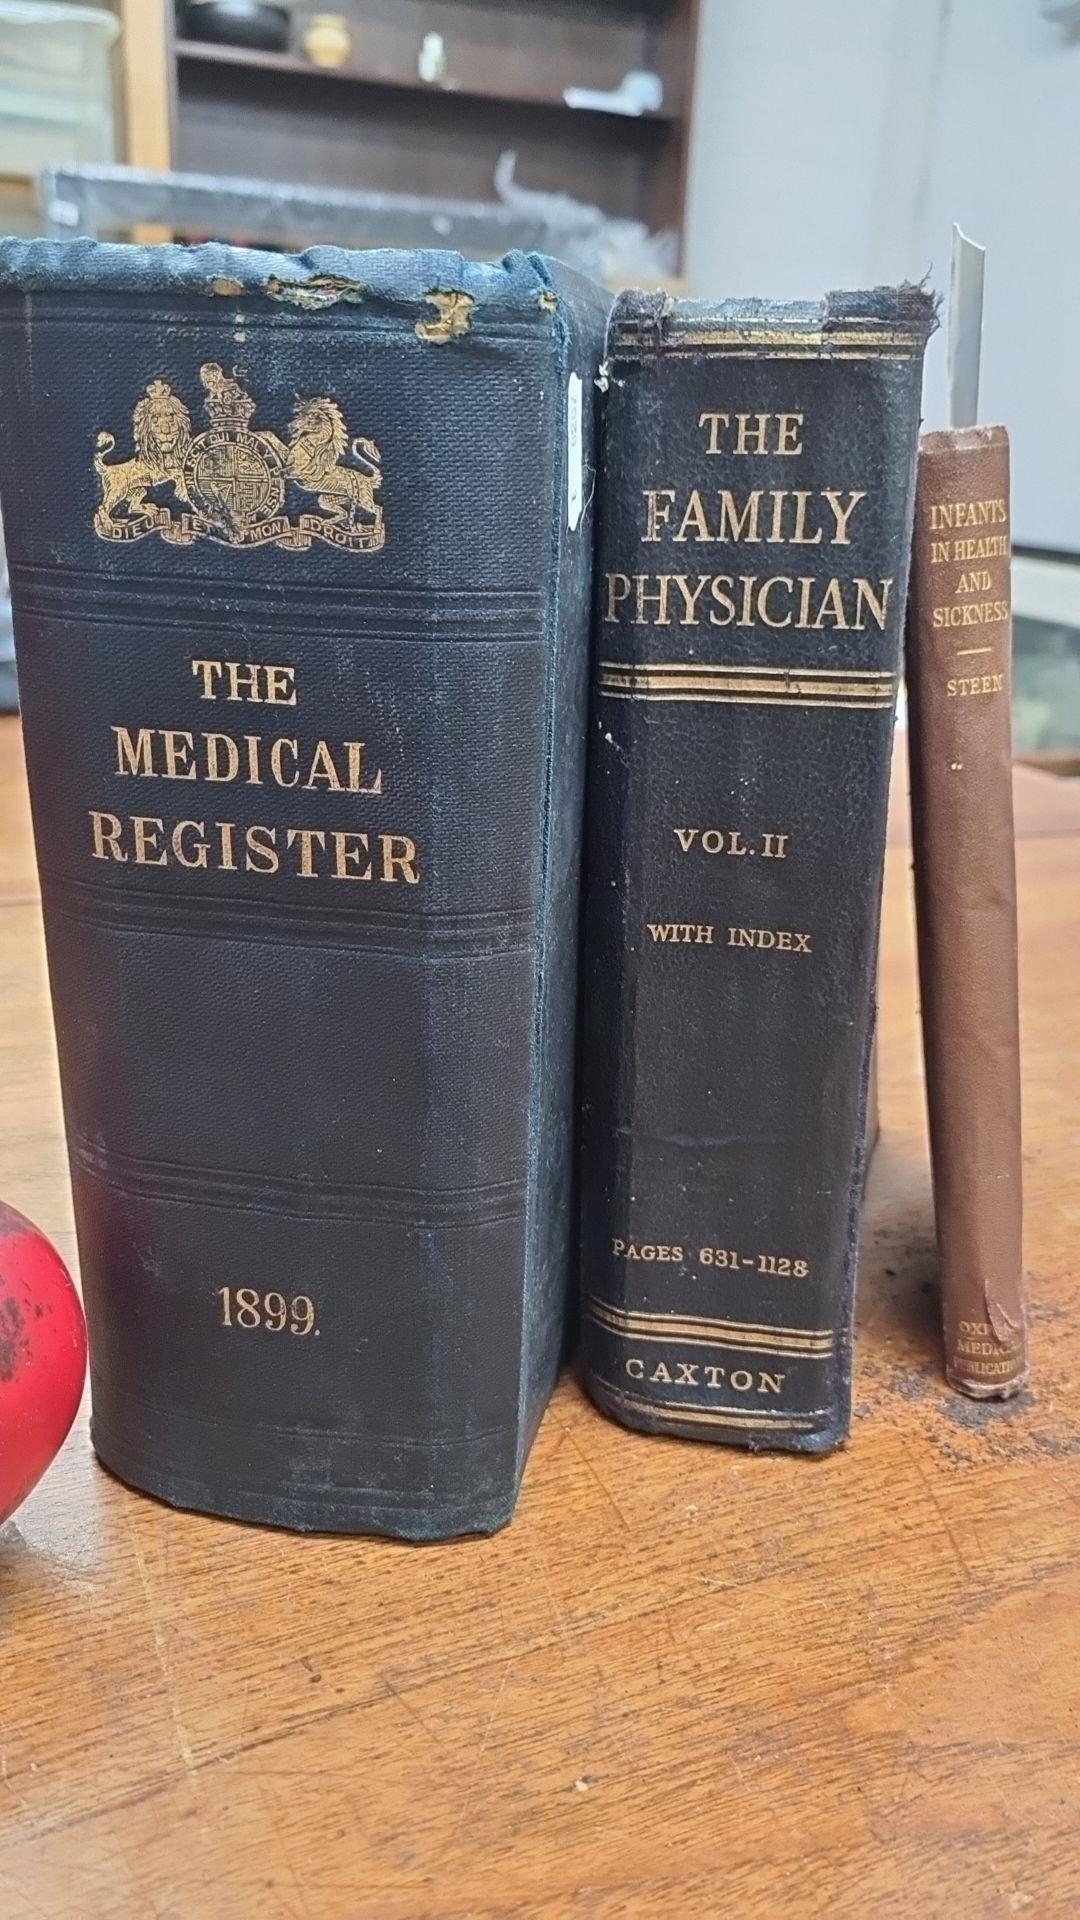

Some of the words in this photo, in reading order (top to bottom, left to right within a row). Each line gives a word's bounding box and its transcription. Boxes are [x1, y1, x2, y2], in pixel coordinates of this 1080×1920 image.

[698, 413, 804, 455] THE
[640, 489, 867, 545] FAMILY
[929, 499, 1007, 531] INFANTS
[111, 518, 155, 540] DIEU
[250, 521, 284, 542] MON
[310, 518, 370, 549] DROIT
[931, 541, 950, 564] IN
[954, 535, 1008, 561] HEALTH
[955, 570, 992, 594] AND
[604, 572, 894, 631] PHYSICIAN
[932, 600, 1009, 628] SICKNESS
[191, 659, 297, 705] THE
[947, 674, 1004, 697] STEEN
[110, 725, 382, 794] MEDICAL
[88, 810, 420, 884] REGISTER
[646, 923, 715, 944] WITH
[727, 927, 813, 953] INDEX
[611, 1238, 684, 1262] PAGES
[700, 1247, 810, 1278] 631-1128
[625, 1358, 786, 1393] CAXTON
